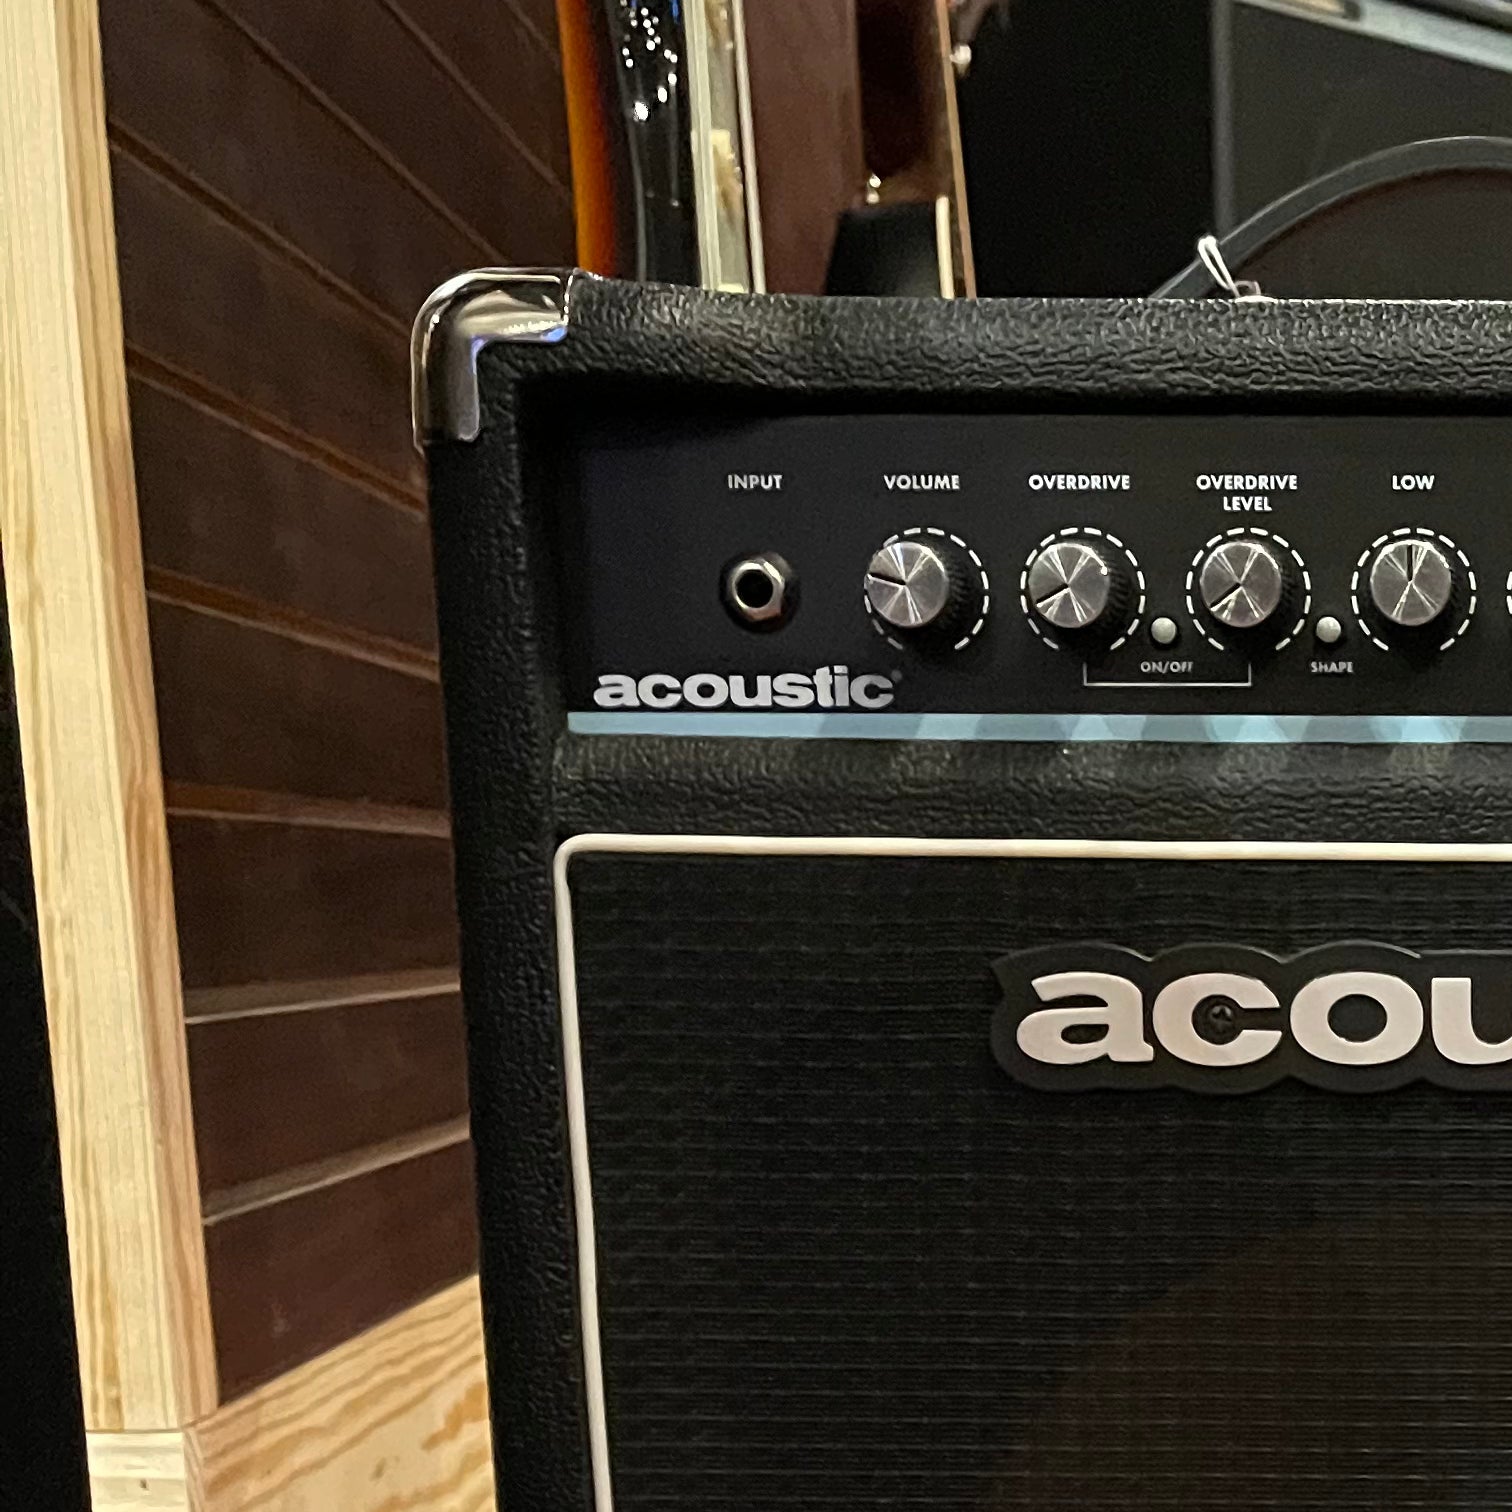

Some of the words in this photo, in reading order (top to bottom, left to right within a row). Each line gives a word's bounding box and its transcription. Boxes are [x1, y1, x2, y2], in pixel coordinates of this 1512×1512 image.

[727, 474, 783, 490] INPUT
[883, 474, 960, 490] VOLUME
[1028, 474, 1130, 490] OVERDRIVE
[1196, 474, 1298, 490] OVERDRIVE
[1392, 474, 1434, 490] LOW
[1223, 496, 1273, 512] LEVEL
[1140, 661, 1194, 674] ON/OFF
[1310, 661, 1354, 674] SHAPE
